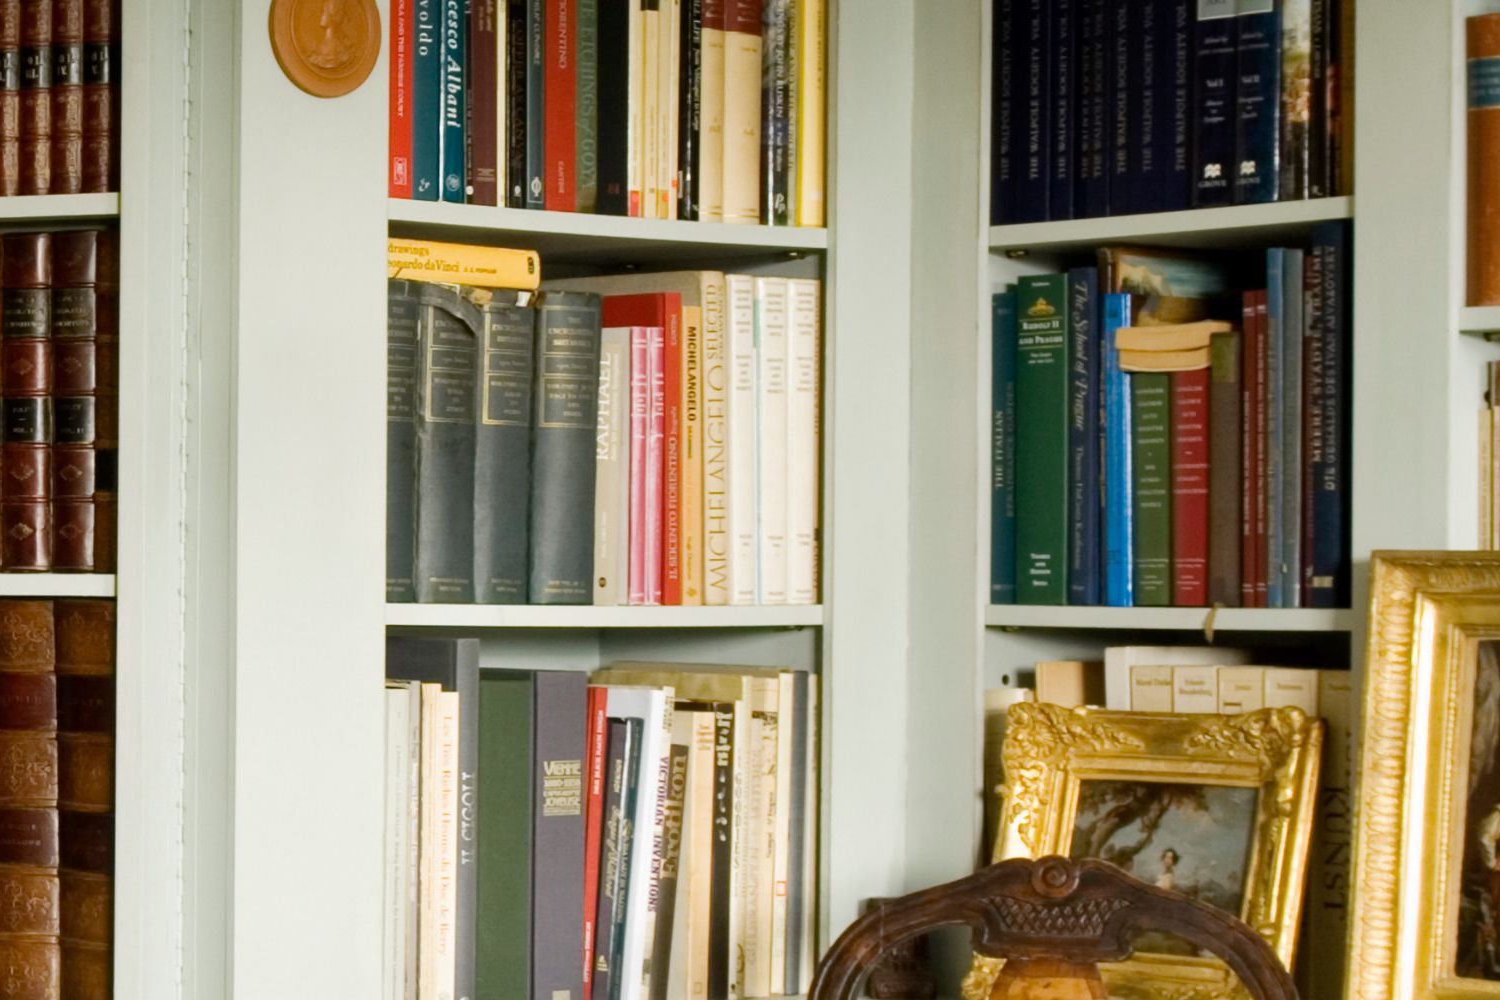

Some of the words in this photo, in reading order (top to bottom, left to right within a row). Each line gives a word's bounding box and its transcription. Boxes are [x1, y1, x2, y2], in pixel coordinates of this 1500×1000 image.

[582, 27, 596, 115] ETCHINGS
[1031, 47, 1041, 96] SOCIETY
[1117, 36, 1128, 88] SOCIETY
[1176, 32, 1187, 85] SOCIETY
[447, 54, 462, 128] Albani
[775, 81, 784, 118] RUSKIN
[1117, 91, 1127, 146] WALPOLE
[1176, 88, 1187, 144] WALPOLE
[1030, 100, 1040, 153] WALPOLE
[582, 139, 596, 190] GOYA
[436, 261, 460, 273] Vinci
[687, 325, 697, 422] MICHELANGELO
[596, 351, 612, 461] RAPHAEL
[669, 436, 678, 508] FIORENTINO
[706, 363, 727, 592] MICHELANGELO
[669, 510, 678, 567] SEICENTO
[655, 756, 669, 826] VICTORIAN
[660, 754, 687, 880] Erotikon
[647, 834, 663, 913] INVENTIONS
